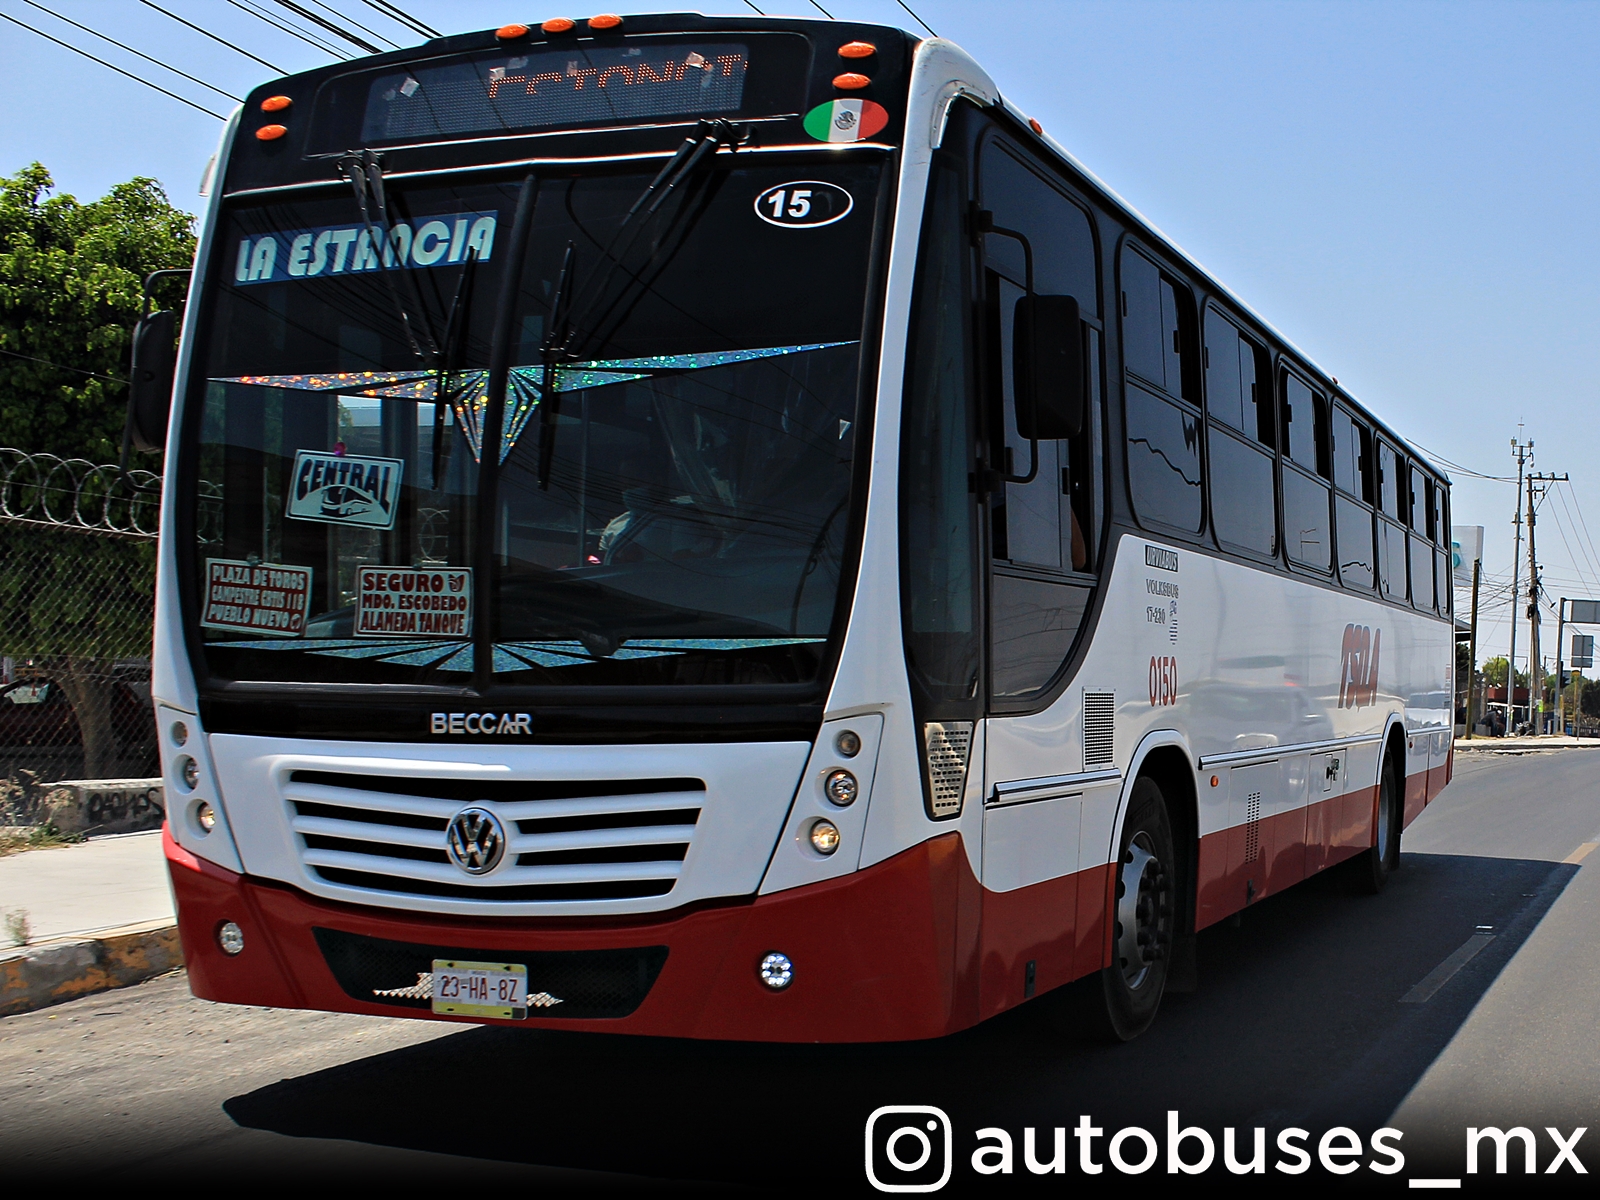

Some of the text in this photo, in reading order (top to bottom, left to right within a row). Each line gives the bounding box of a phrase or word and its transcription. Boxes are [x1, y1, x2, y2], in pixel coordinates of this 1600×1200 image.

[767, 189, 812, 218] 15
[235, 216, 497, 281] LA ESTANCIA
[296, 458, 391, 515] CENTRAL
[212, 564, 305, 590] PLAZA DE TOROS
[362, 572, 444, 592] SEGURO
[1145, 578, 1179, 599] VOLKSBUS
[361, 593, 467, 612] MDO. ESCOBEDO
[207, 603, 290, 629] PUEBLO NUEVO
[360, 611, 466, 634] ALAMEDA TANQUE
[1149, 655, 1178, 707] 0150
[430, 712, 533, 735] BECCAR
[440, 974, 519, 1003] 23-HA-8Z
